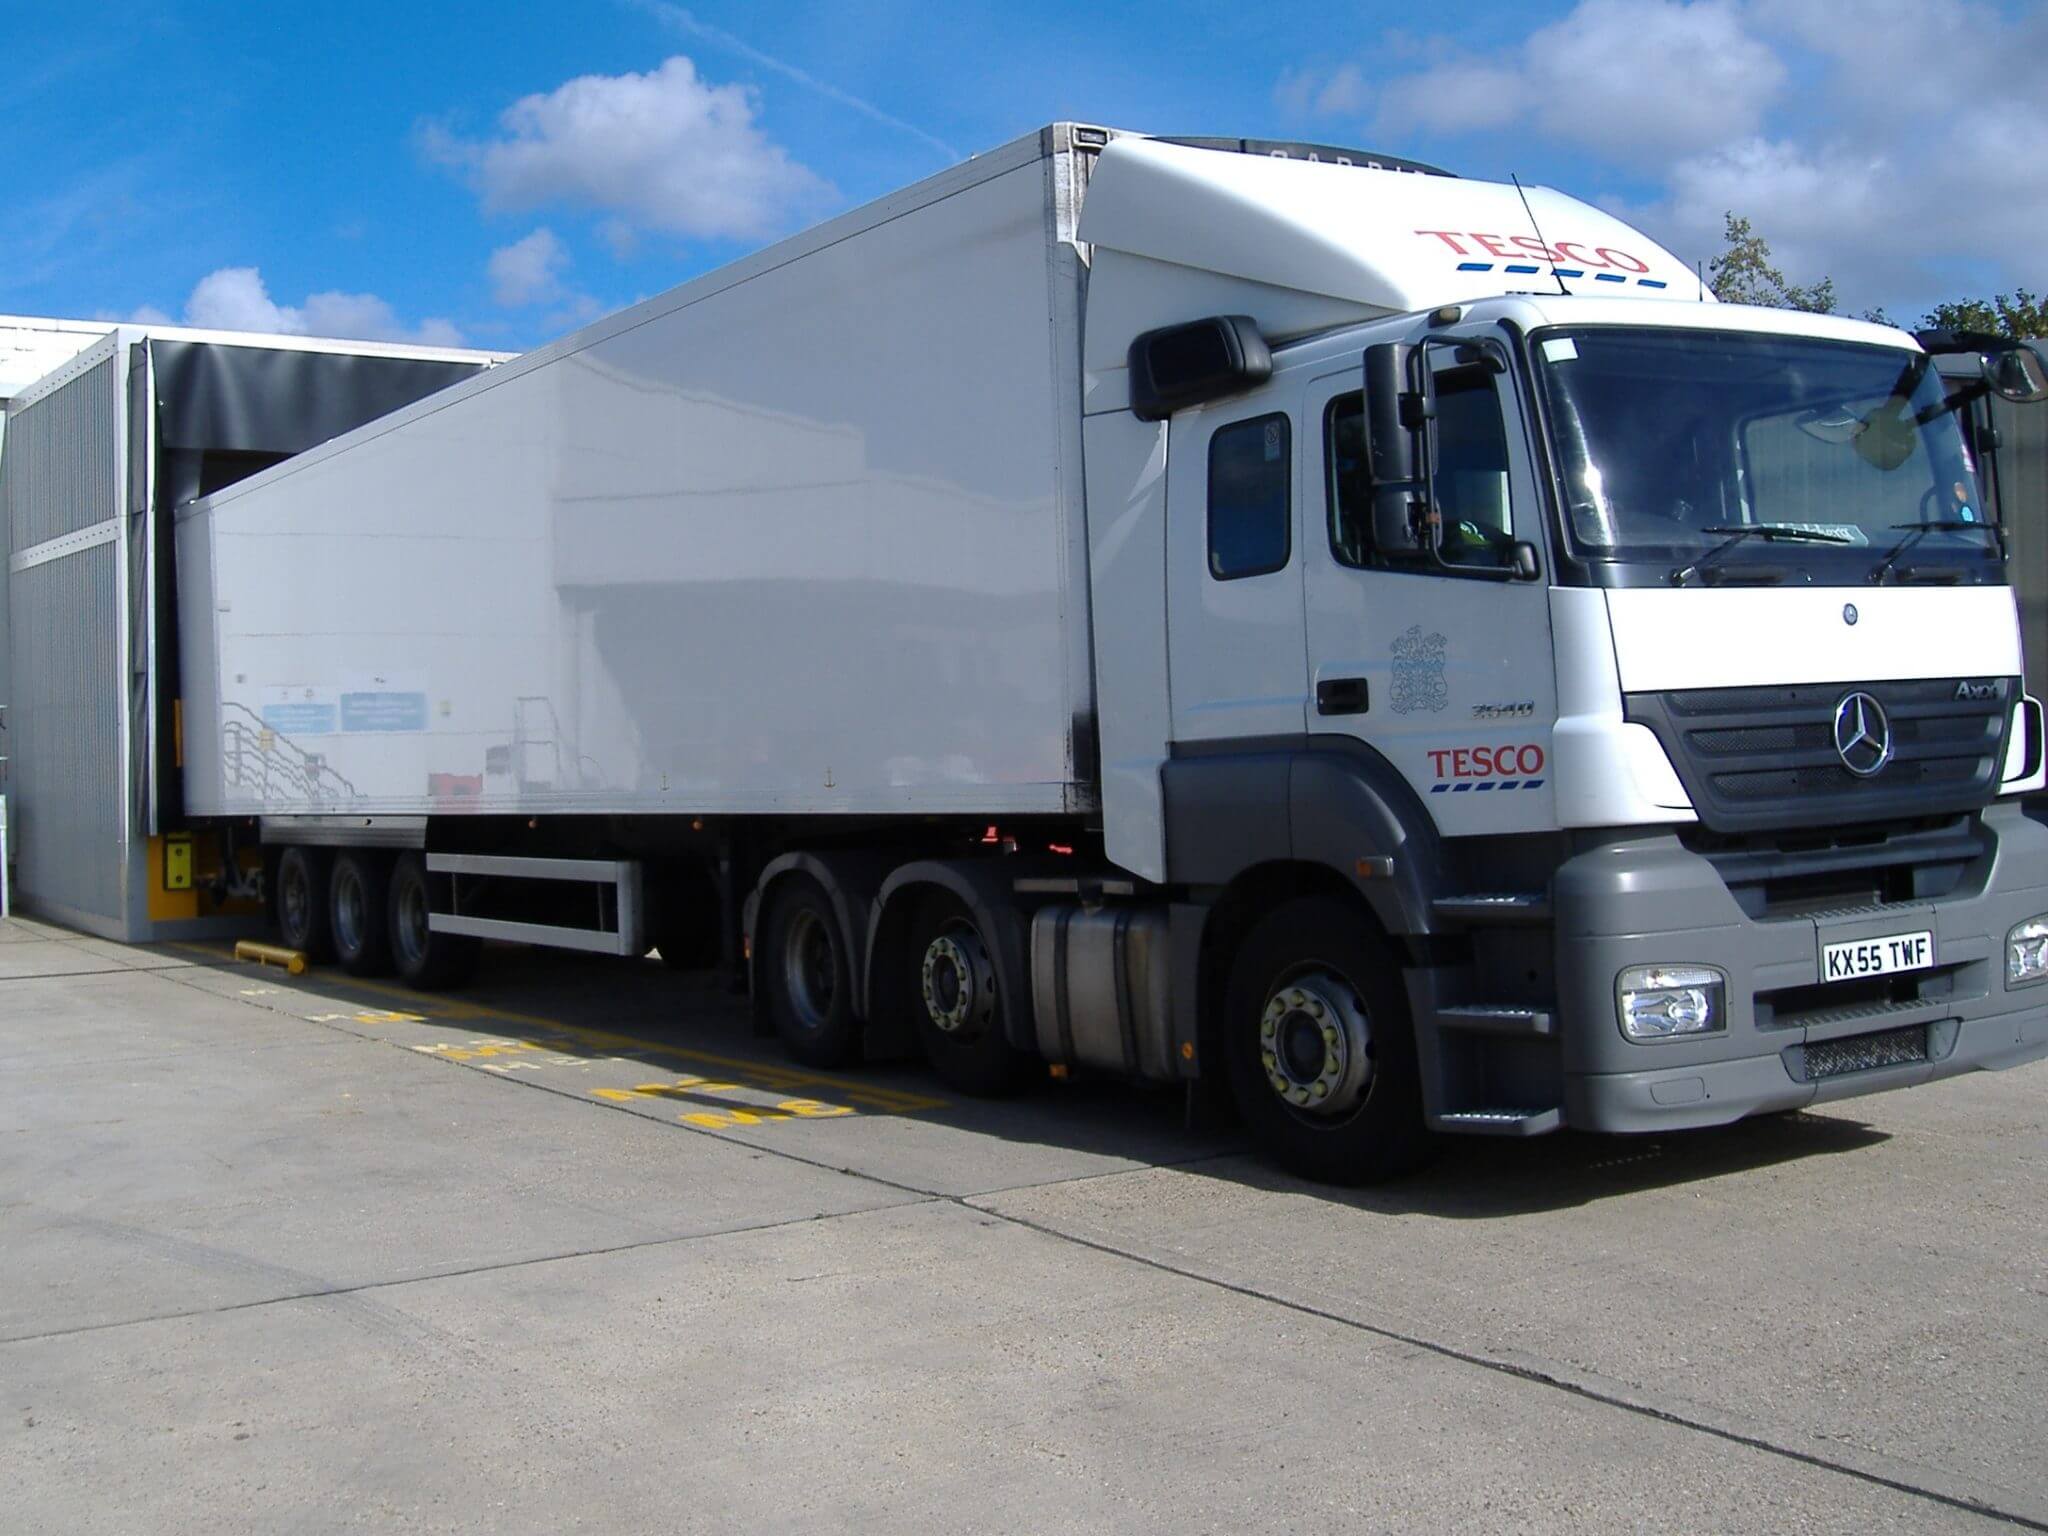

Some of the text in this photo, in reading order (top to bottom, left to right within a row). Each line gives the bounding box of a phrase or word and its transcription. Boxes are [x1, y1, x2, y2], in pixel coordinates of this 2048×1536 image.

[1414, 230, 1649, 273] TESCO
[1427, 744, 1544, 778] TESCO
[1829, 938, 1926, 977] KX55 TWF
